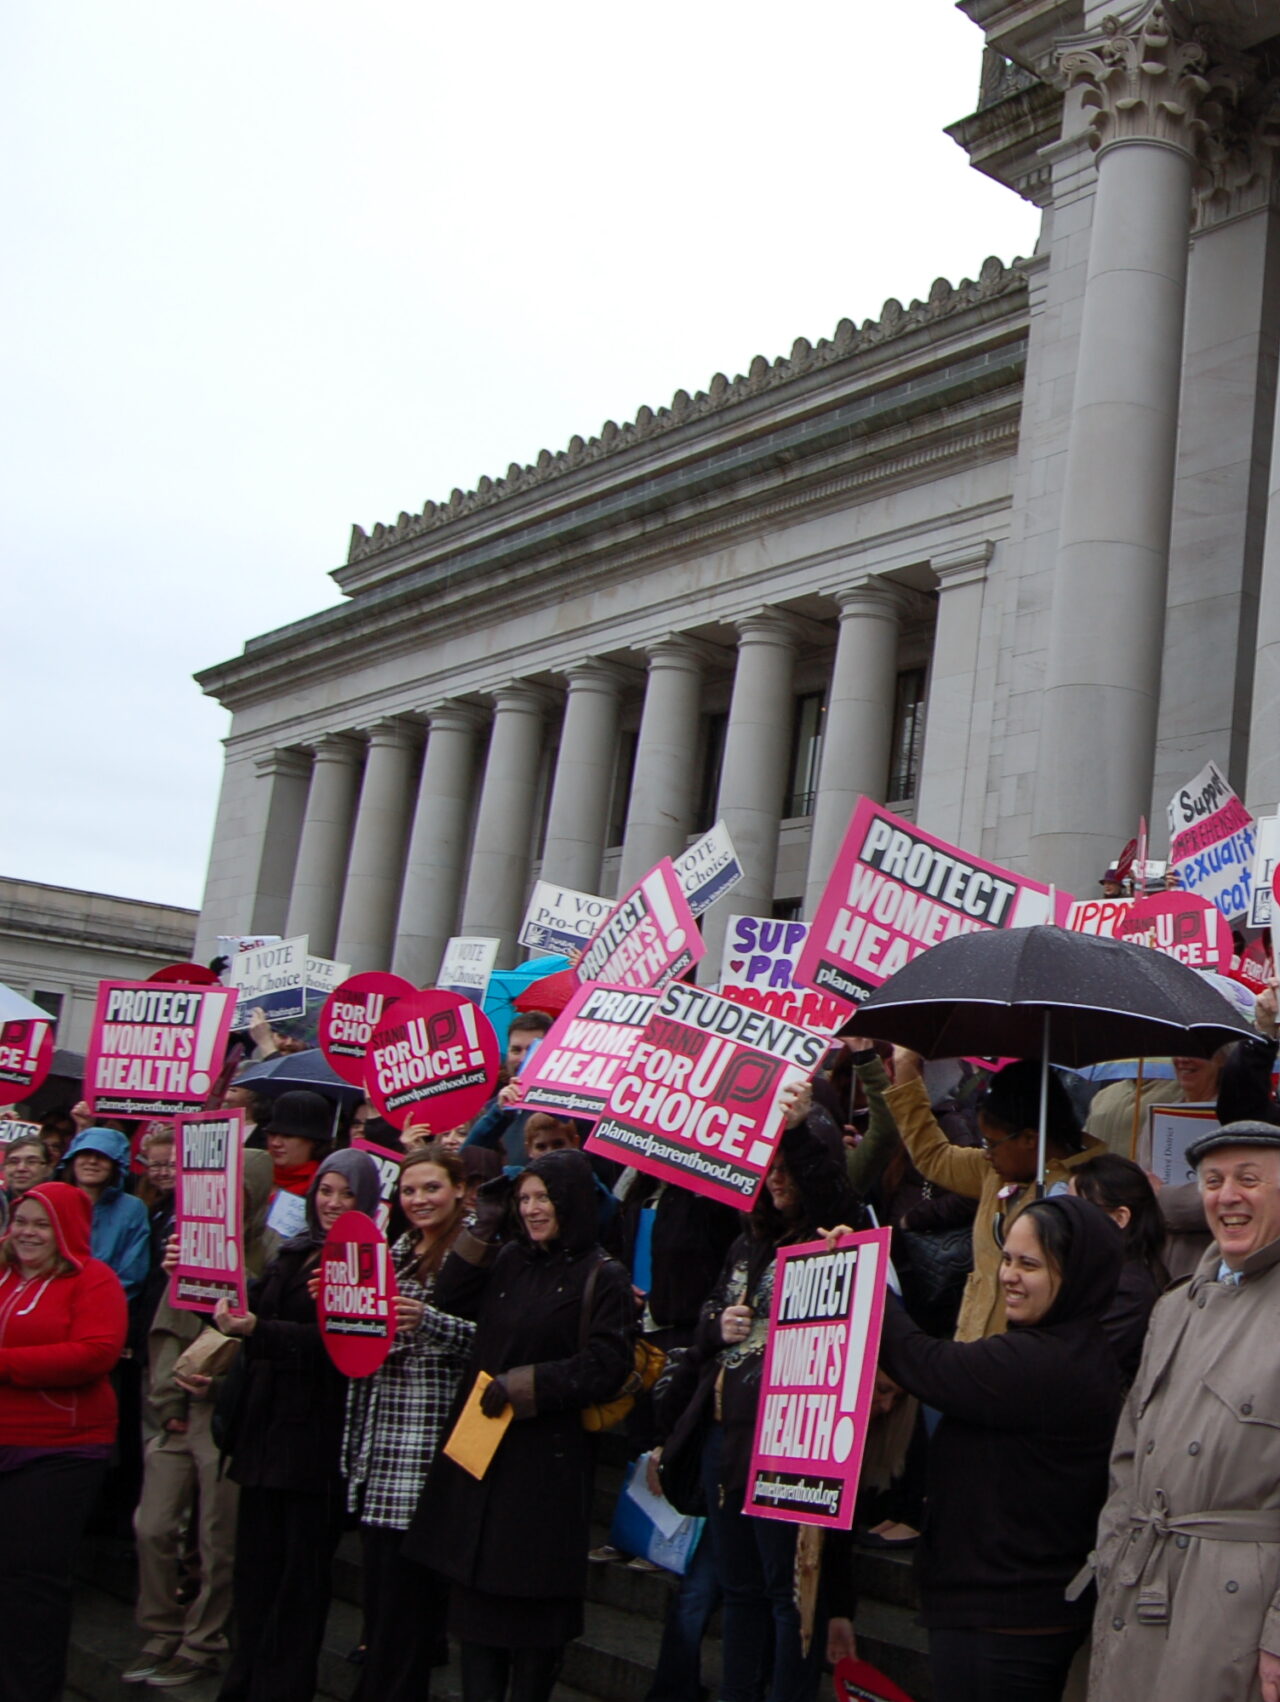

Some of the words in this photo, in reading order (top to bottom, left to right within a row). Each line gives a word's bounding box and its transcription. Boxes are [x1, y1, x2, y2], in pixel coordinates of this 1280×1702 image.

[860, 819, 1015, 925] PROTECT
[577, 890, 647, 984] PROTECT
[106, 990, 202, 1024] PROTECT
[644, 1017, 704, 1056] STAND
[660, 984, 825, 1067] STUDENTS
[101, 1024, 194, 1059] WOMEN'S
[182, 1122, 230, 1169] PROTECT
[596, 1119, 757, 1195] plannedparenthood.org
[779, 1250, 857, 1320] PROTECT
[770, 1324, 846, 1388] WOMEN'S
